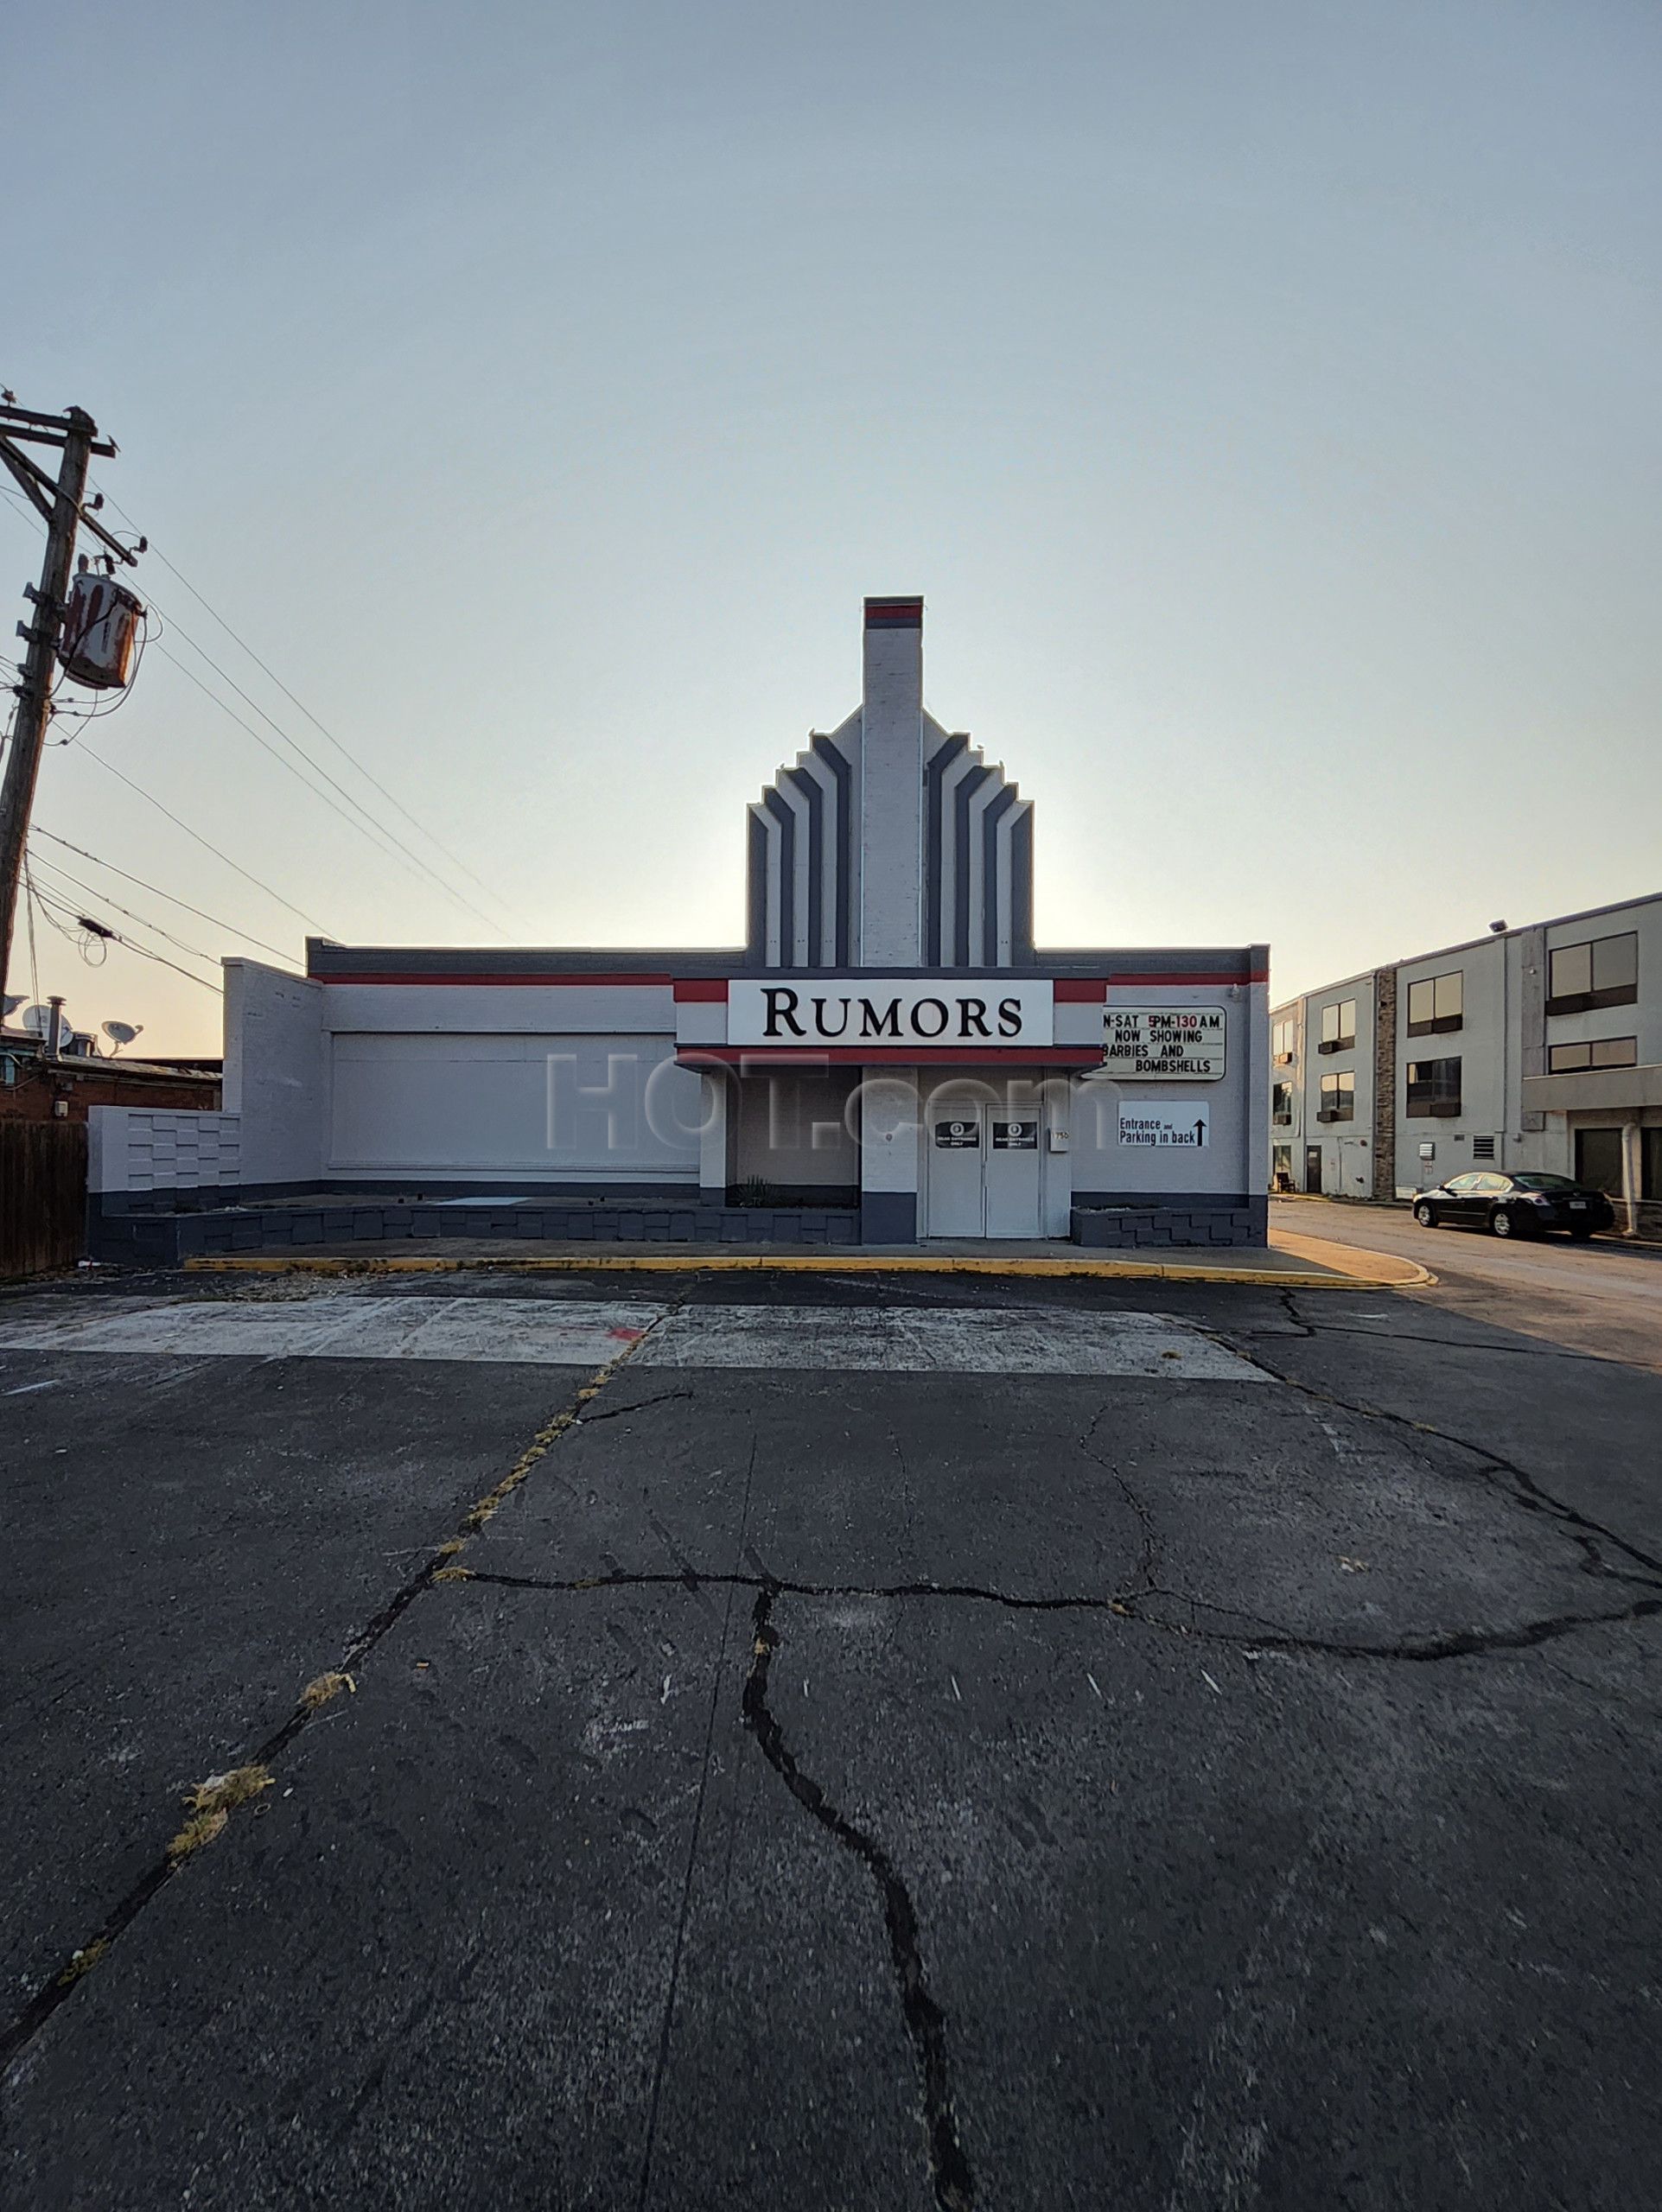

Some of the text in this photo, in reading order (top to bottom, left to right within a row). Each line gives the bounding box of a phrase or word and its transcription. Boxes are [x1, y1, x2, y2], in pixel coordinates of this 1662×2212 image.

[1115, 1030, 1203, 1043] NOW SHOWING
[1160, 1045, 1184, 1058] AND
[1135, 1059, 1211, 1072] BOMBSHELLS
[1119, 1117, 1161, 1129] Entrance
[1119, 1129, 1195, 1147] Parking in back
